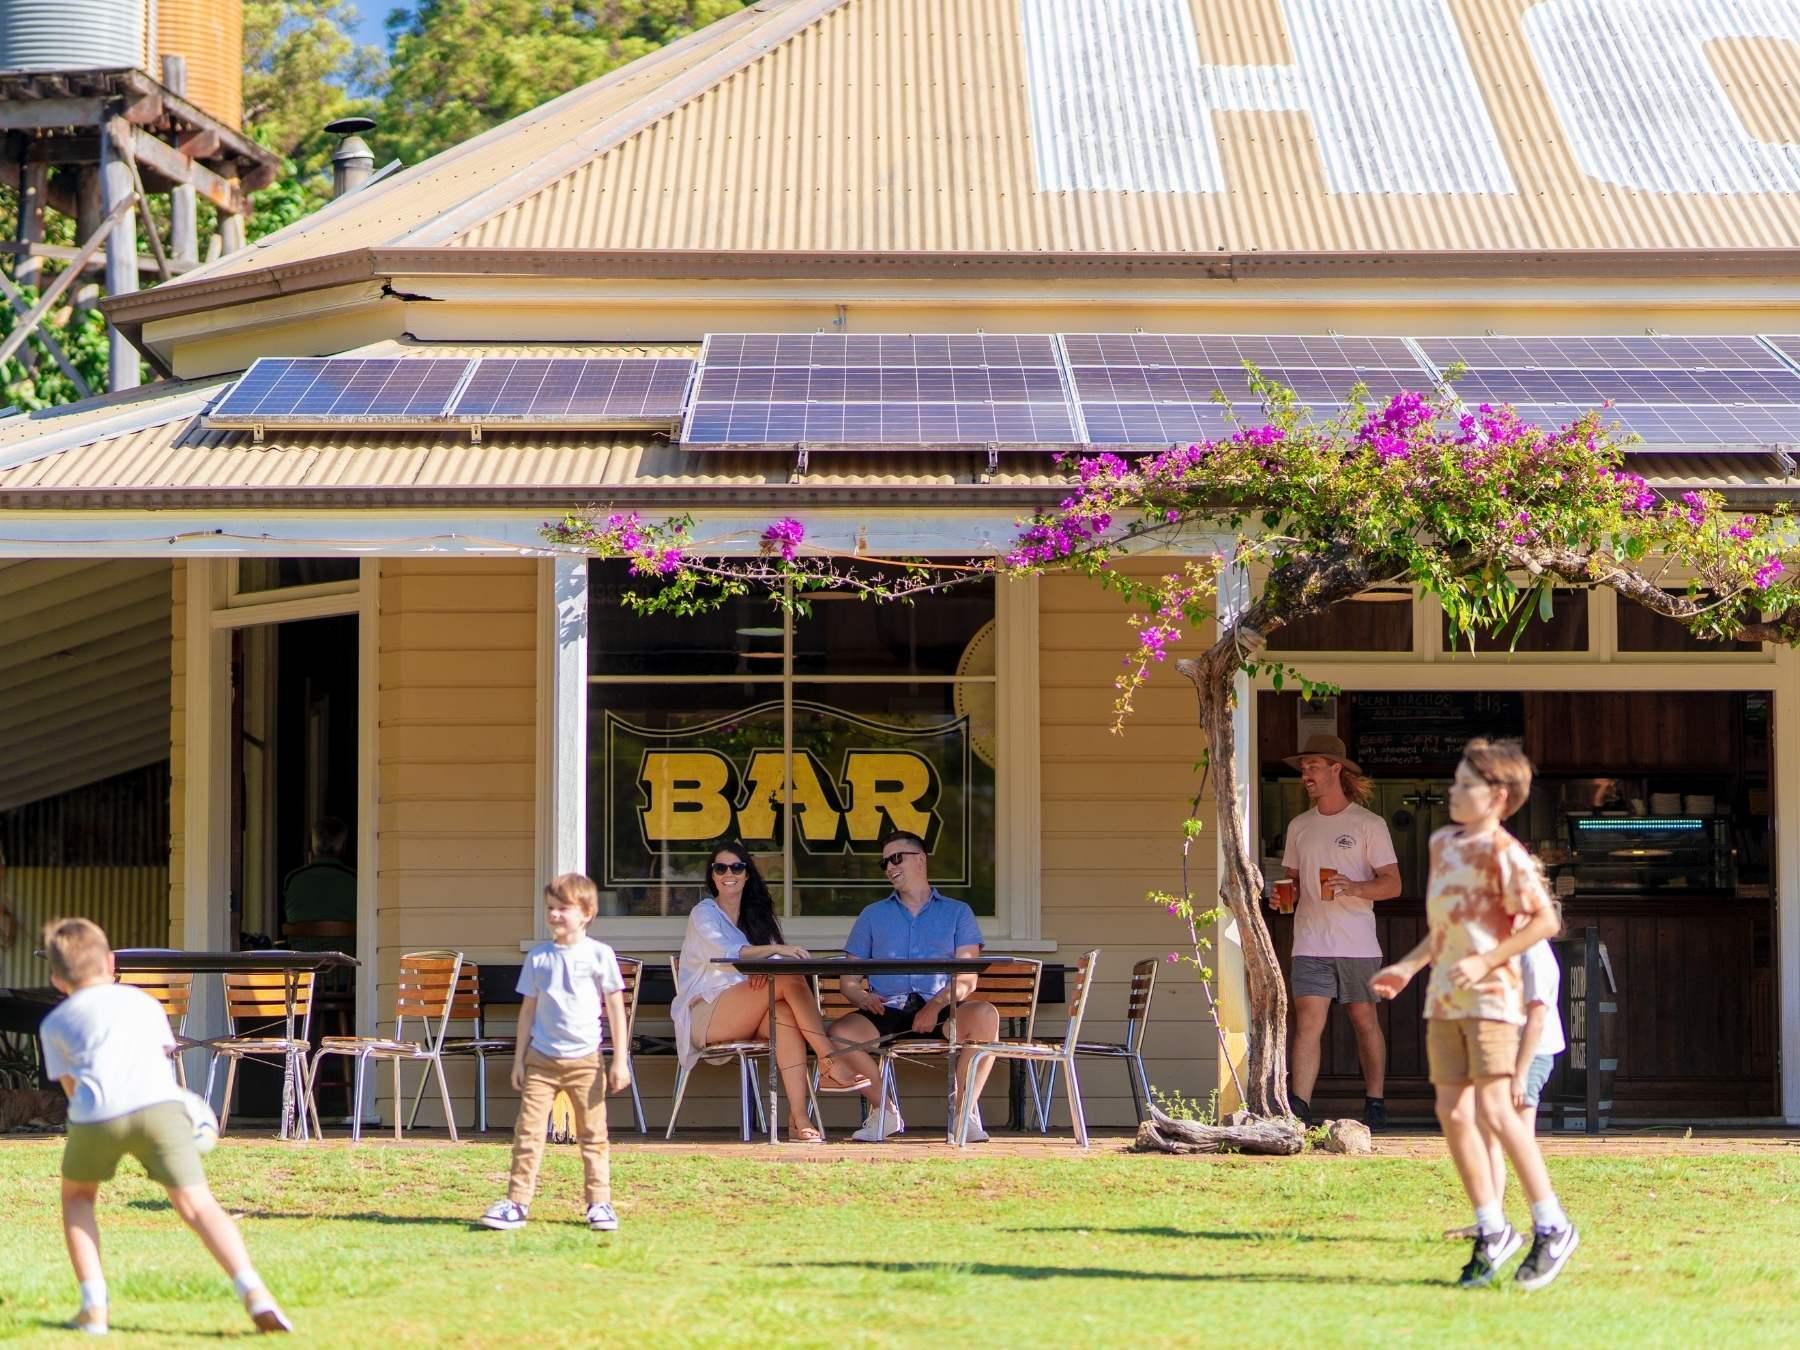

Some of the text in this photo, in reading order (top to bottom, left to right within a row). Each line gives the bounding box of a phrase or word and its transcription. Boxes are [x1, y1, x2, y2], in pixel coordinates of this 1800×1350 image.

[1398, 694, 1453, 706] NACHOS
[641, 753, 932, 841] BAR
[1570, 1001, 1586, 1039] COFF
